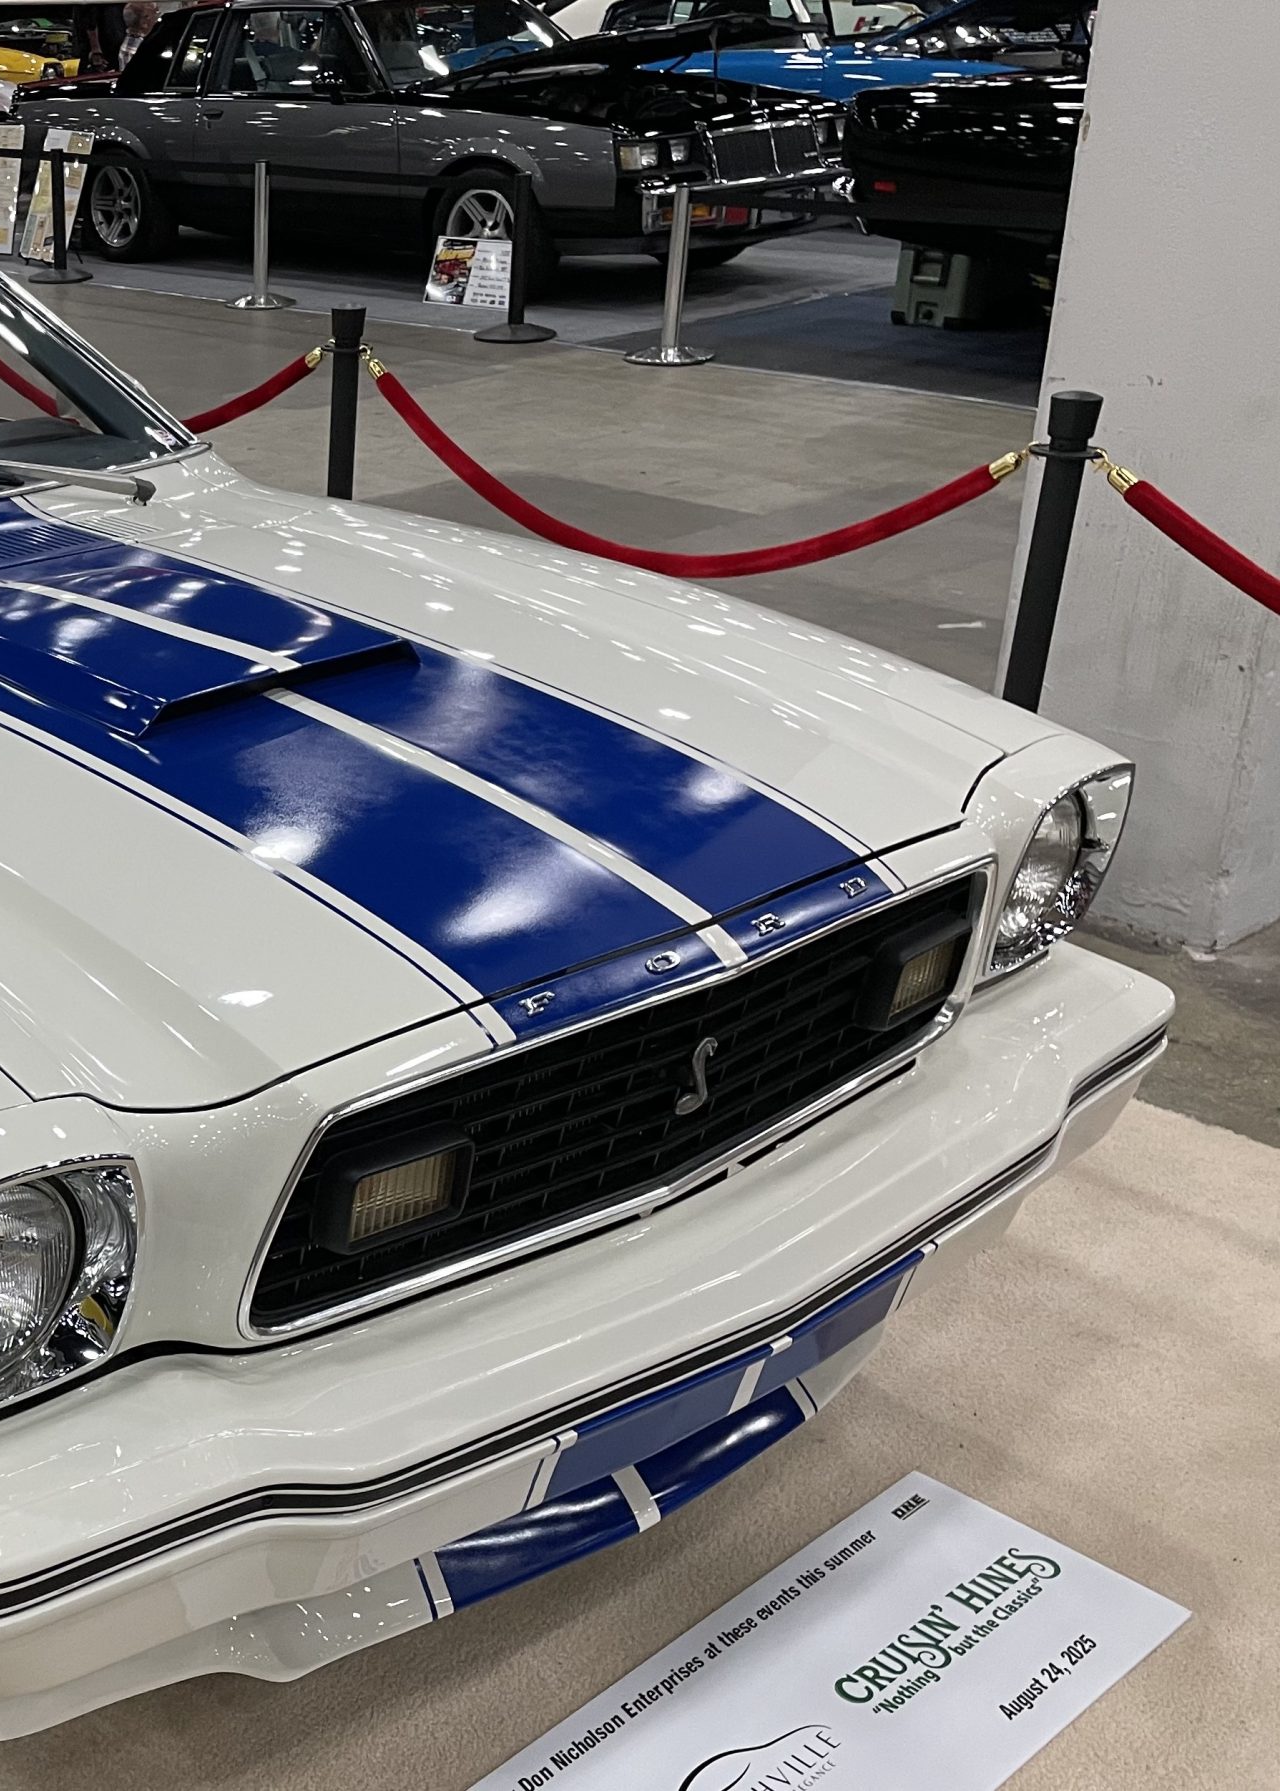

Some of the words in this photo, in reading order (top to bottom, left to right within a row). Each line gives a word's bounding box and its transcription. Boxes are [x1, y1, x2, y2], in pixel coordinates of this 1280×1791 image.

[518, 876, 868, 1016] FORD
[945, 1548, 1061, 1615] HINES
[517, 1766, 555, 1791] Don
[549, 1714, 626, 1771] Nicholson
[620, 1655, 705, 1719] Enterprises
[703, 1642, 722, 1660] at
[717, 1616, 758, 1650] these
[756, 1589, 801, 1622] events
[795, 1567, 826, 1590] this
[823, 1529, 877, 1571] summer
[948, 1634, 979, 1656] but
[972, 1619, 1000, 1638] the
[998, 1677, 1049, 1721] August
[1040, 1662, 1071, 1684] 24,
[1060, 1634, 1097, 1666] 2025
